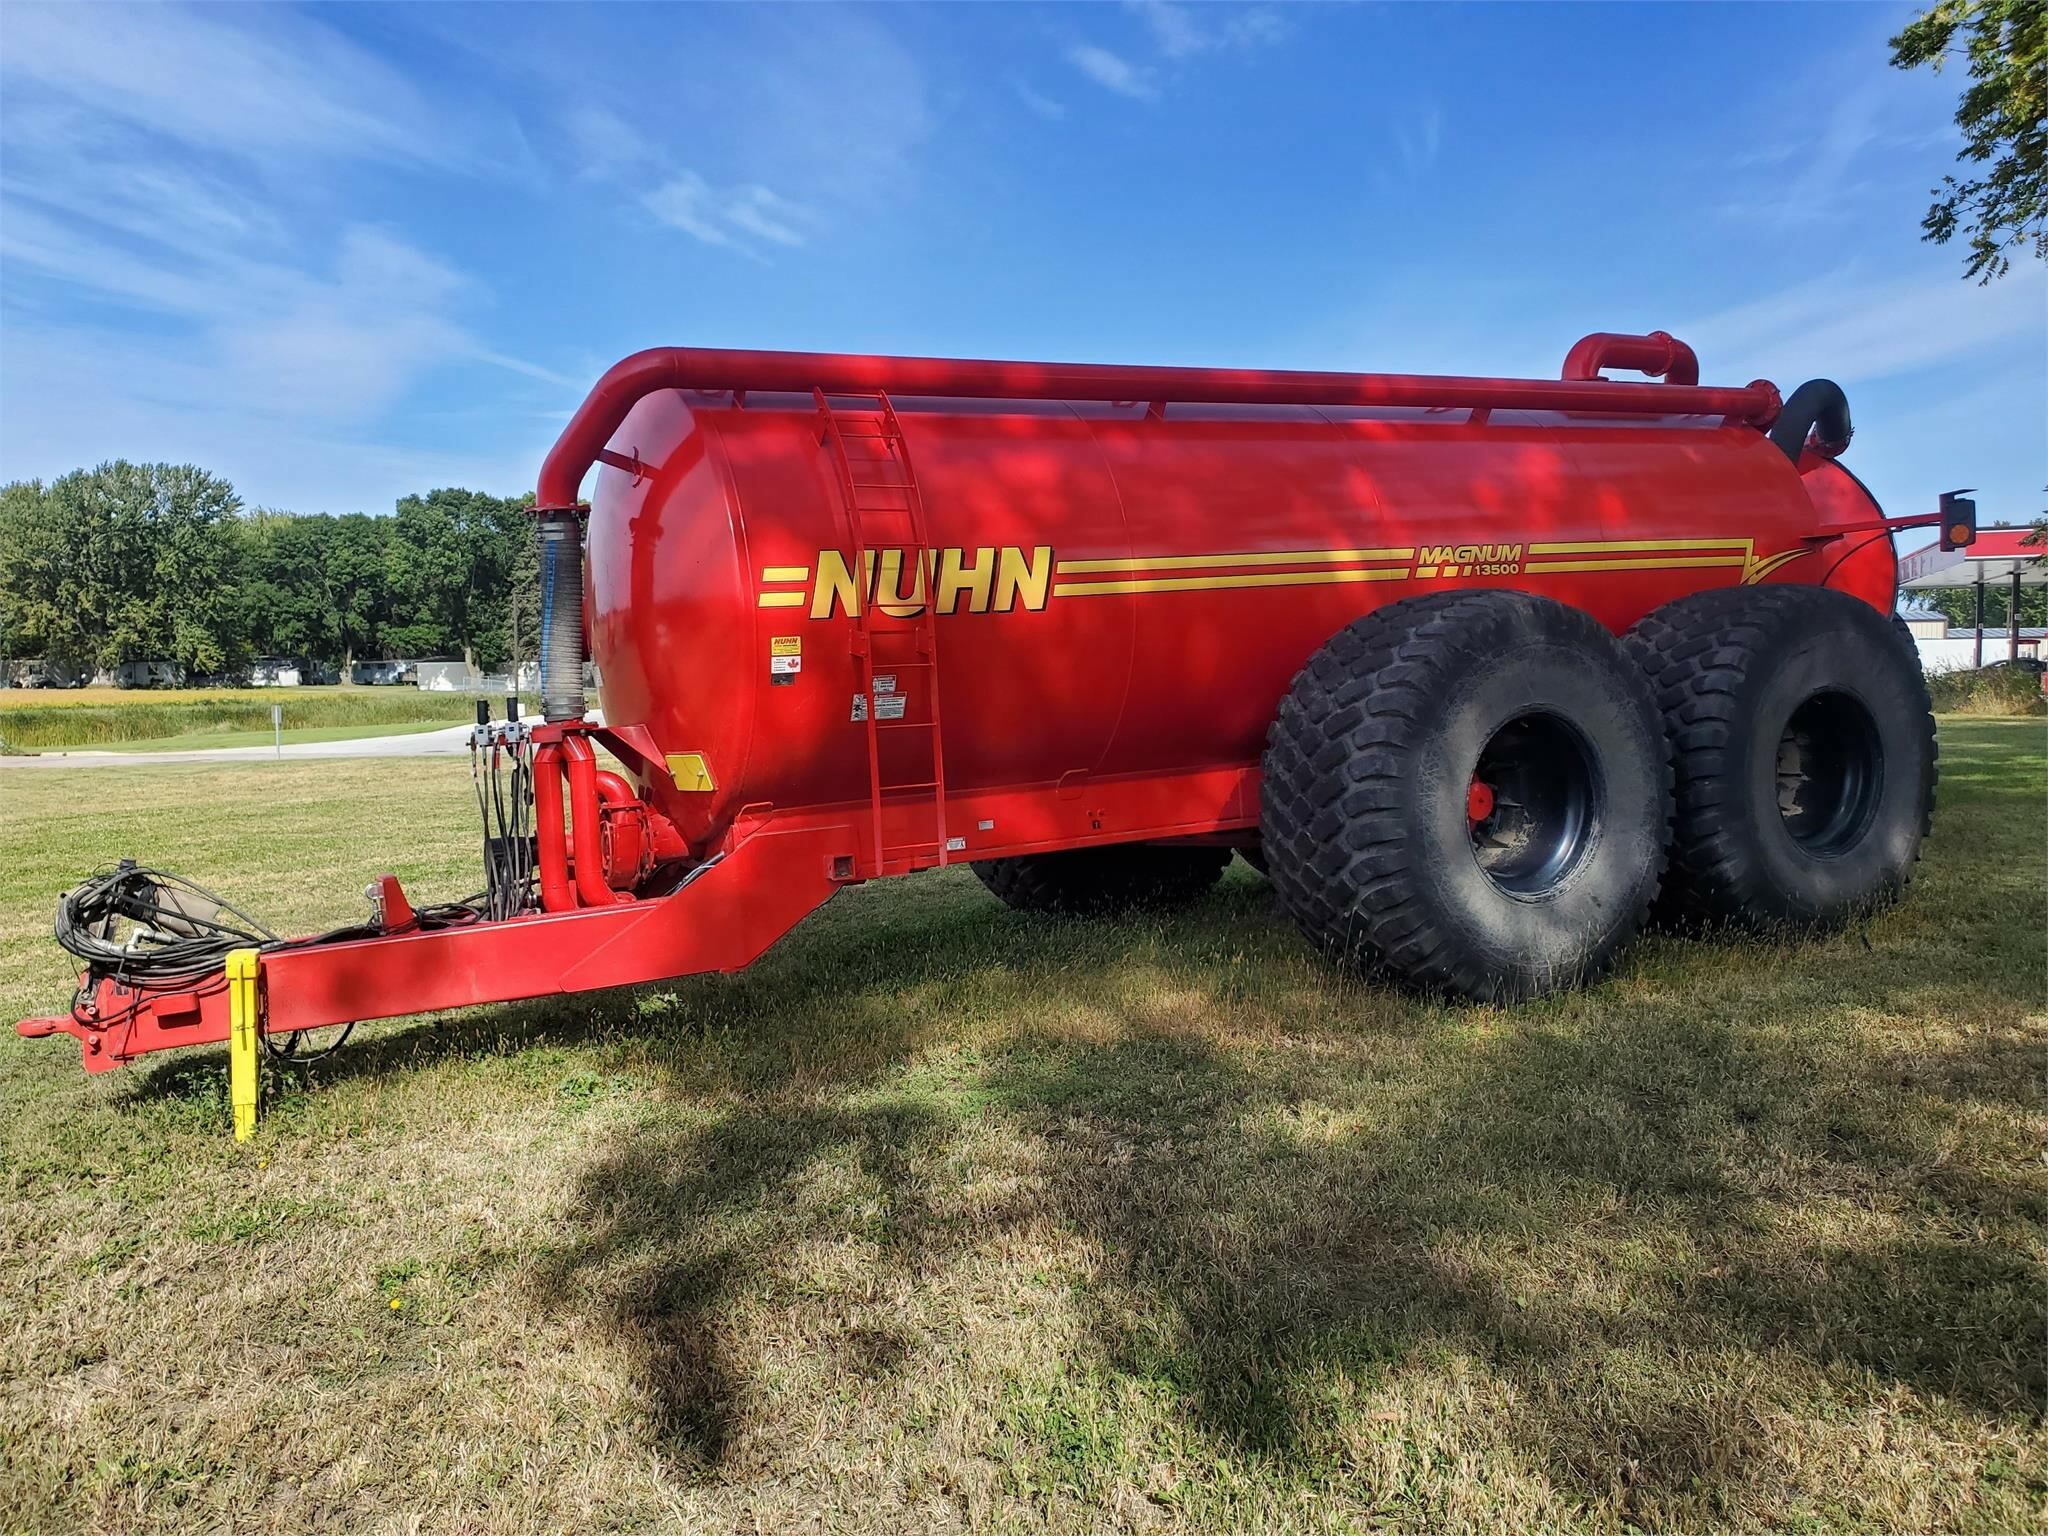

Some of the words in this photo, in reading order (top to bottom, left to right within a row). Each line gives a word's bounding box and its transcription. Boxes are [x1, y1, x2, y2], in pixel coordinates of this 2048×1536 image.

[1418, 544, 1522, 564] MAGNUM
[1474, 563, 1520, 576] 13500
[809, 546, 1053, 619] NUHN
